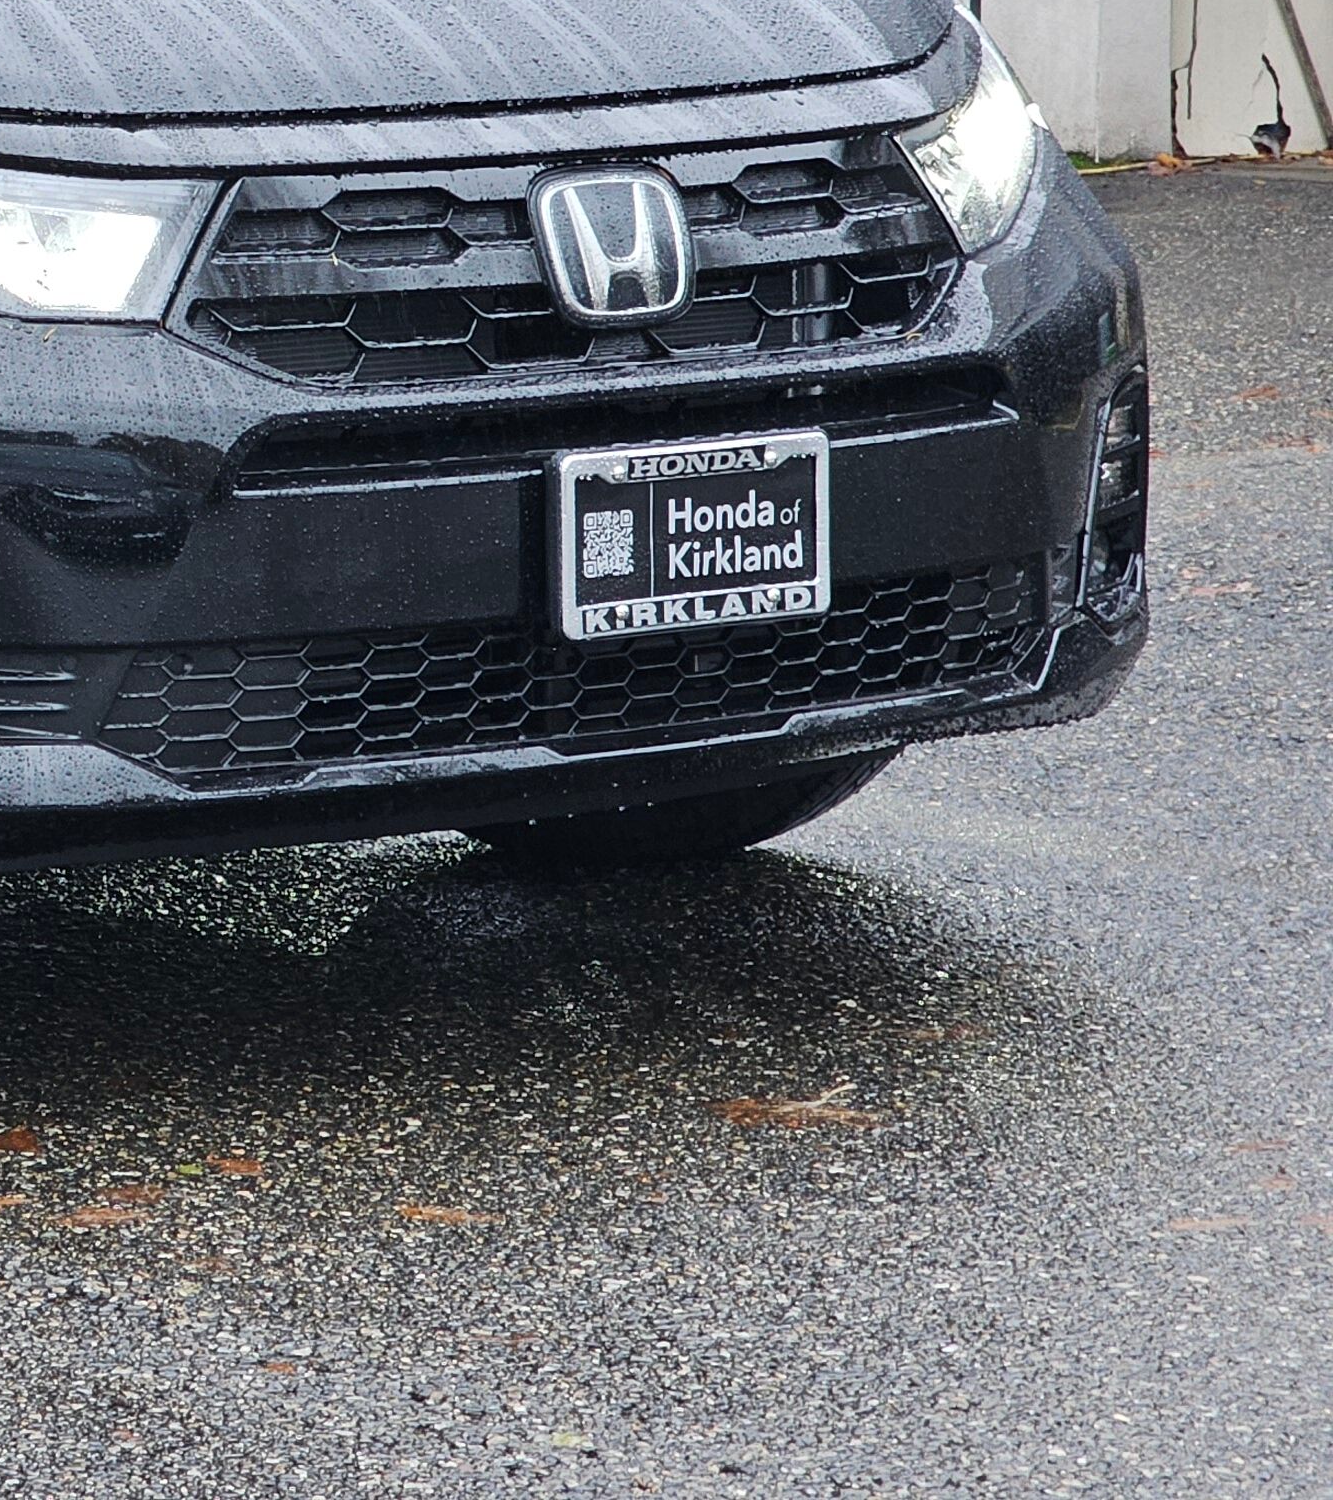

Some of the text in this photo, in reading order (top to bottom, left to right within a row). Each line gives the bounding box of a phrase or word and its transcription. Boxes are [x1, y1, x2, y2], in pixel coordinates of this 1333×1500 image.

[631, 449, 761, 479] HONDA
[668, 489, 802, 534] Honda of
[668, 530, 803, 579] Kirkland
